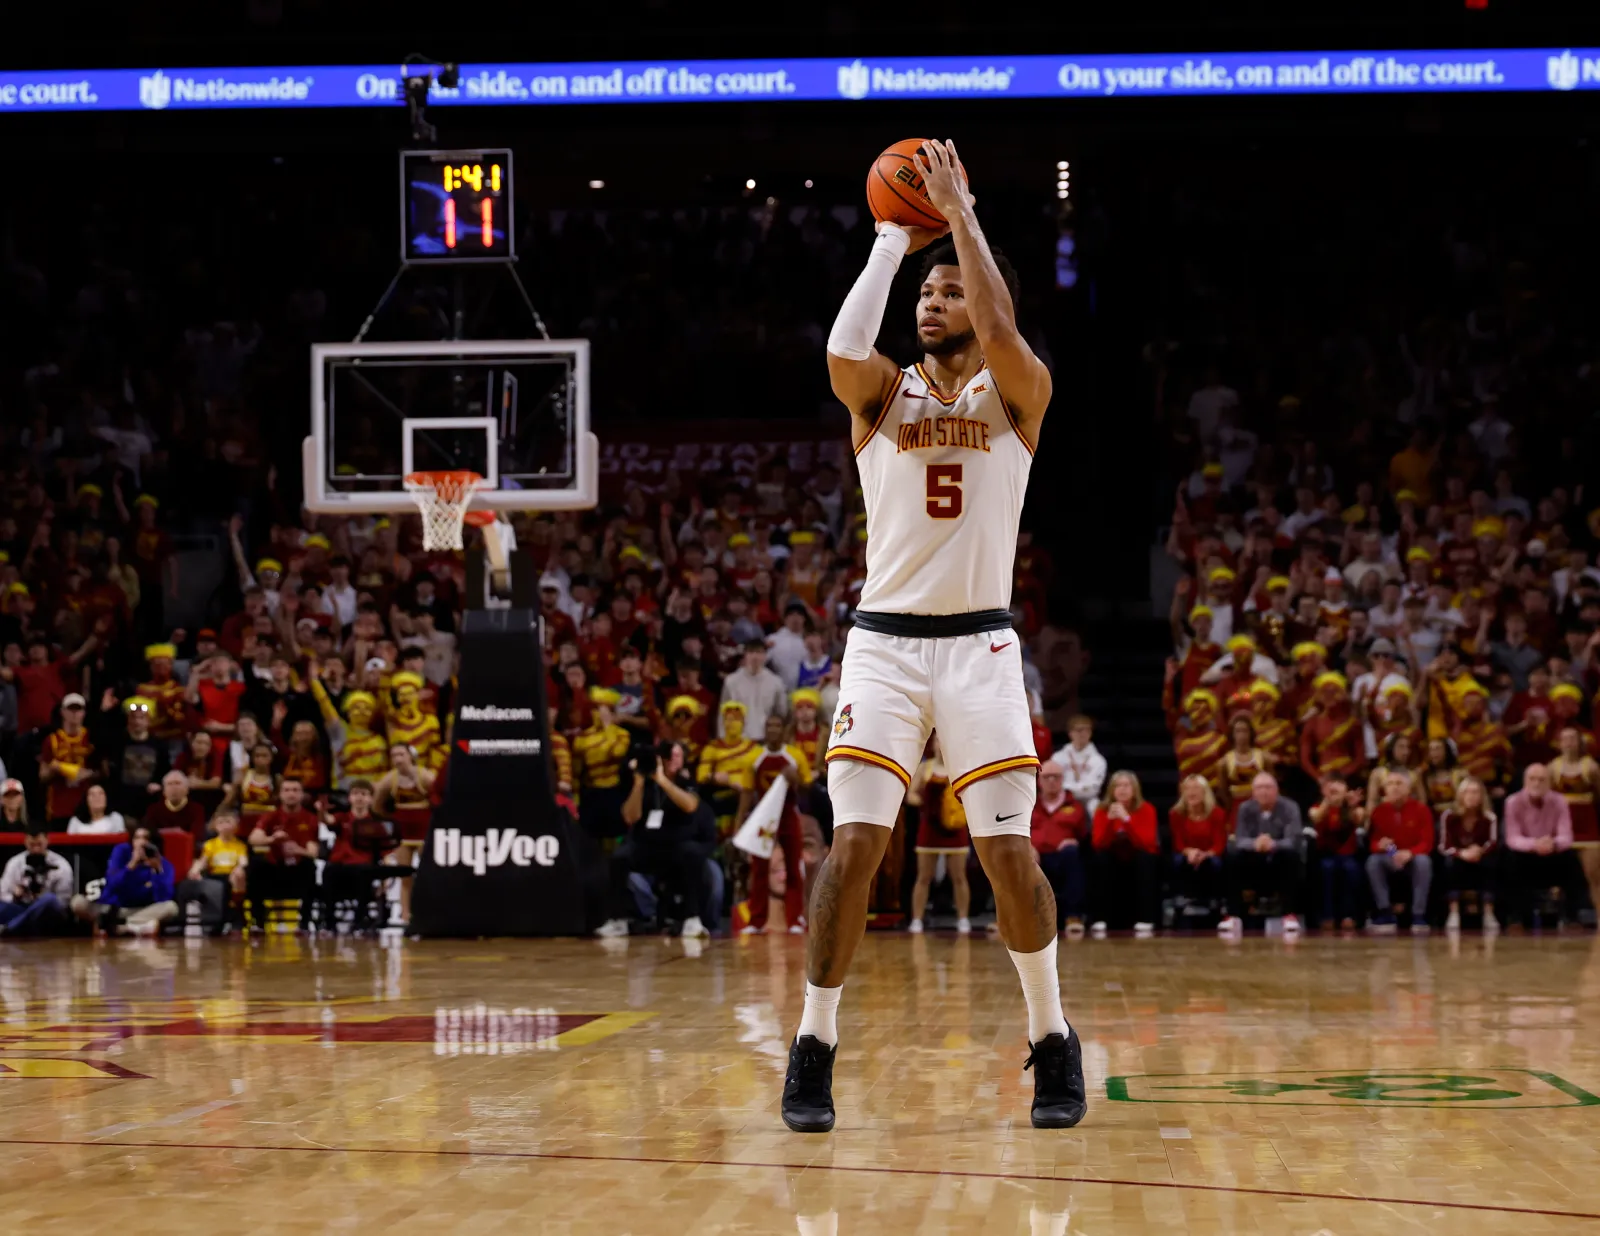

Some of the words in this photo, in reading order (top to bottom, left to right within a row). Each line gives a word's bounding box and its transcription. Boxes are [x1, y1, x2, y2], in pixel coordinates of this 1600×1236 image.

[174, 77, 309, 101] Nationwide
[356, 73, 397, 100] On
[466, 70, 525, 100] side,
[531, 75, 567, 97] on
[570, 67, 623, 97] and
[626, 66, 667, 96] off
[668, 67, 713, 95] the
[715, 69, 796, 95] court.
[872, 67, 1010, 92] Nationwide
[1058, 63, 1100, 90] On
[1103, 67, 1168, 96] your
[1170, 60, 1234, 90] side,
[1236, 65, 1273, 87] on
[1276, 58, 1330, 86] and
[1333, 57, 1375, 86] off
[1375, 57, 1420, 85] the
[1423, 59, 1504, 86] court.
[20, 80, 98, 105] court.
[897, 417, 932, 453] IOWA
[936, 417, 991, 453] STATE
[926, 463, 963, 520] 5
[460, 704, 533, 721] Mediacom
